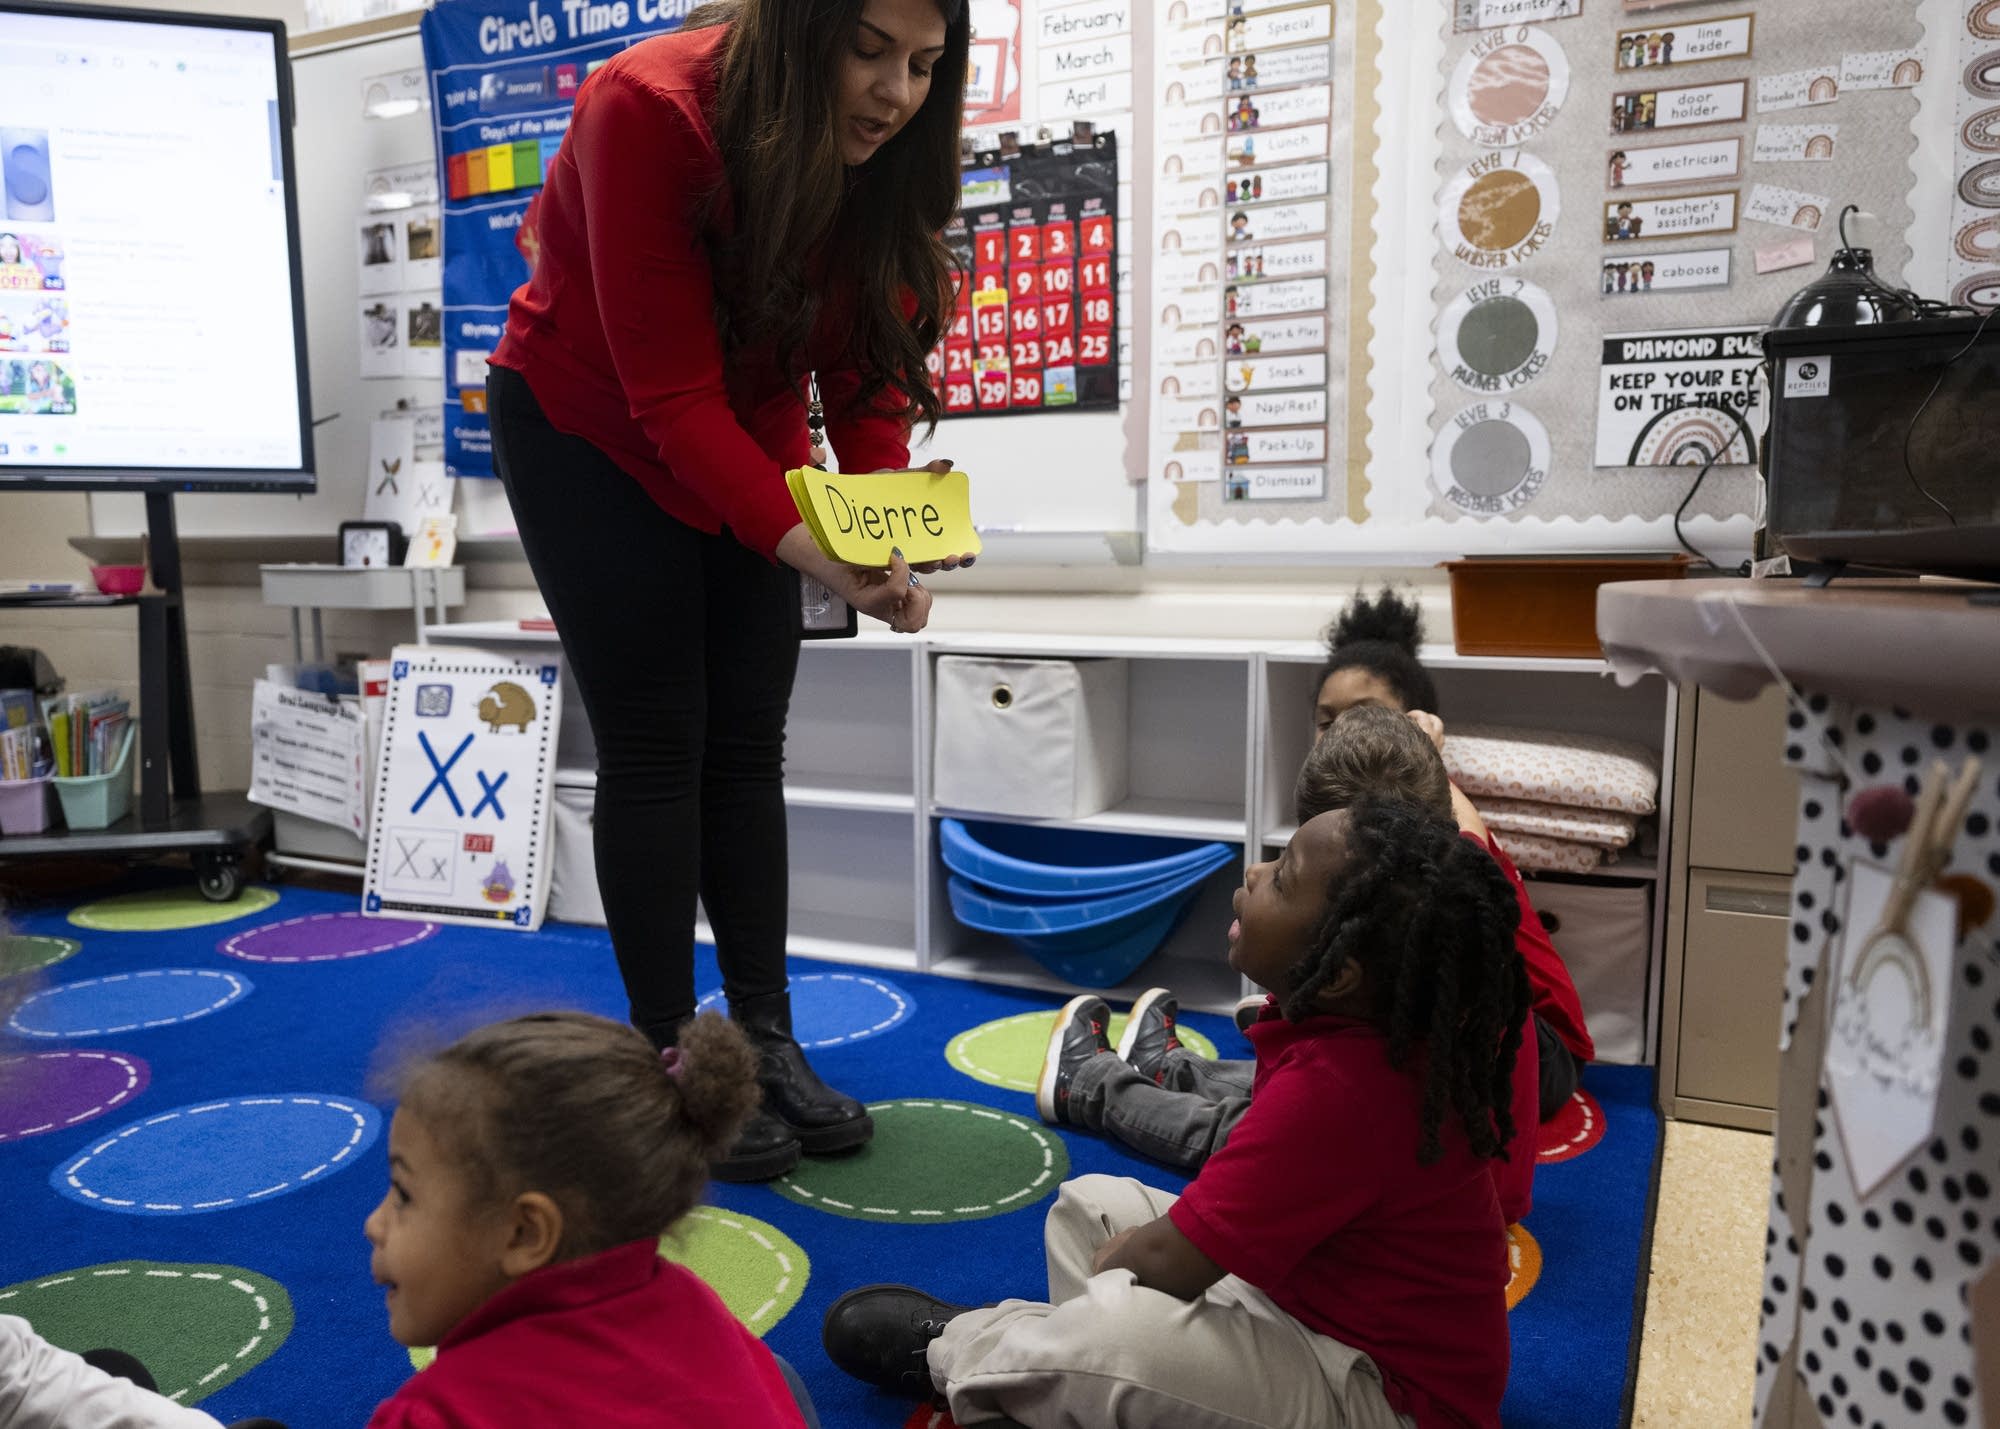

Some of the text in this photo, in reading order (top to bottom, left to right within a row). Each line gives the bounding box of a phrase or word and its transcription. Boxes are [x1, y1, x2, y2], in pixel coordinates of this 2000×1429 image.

[479, 0, 702, 54] Circle Time Cen
[1044, 10, 1126, 37] February
[1267, 16, 1315, 38] Special
[1697, 28, 1722, 39] line
[1470, 30, 1506, 58] LEVEL
[1686, 40, 1732, 54] leader
[1056, 47, 1113, 71] March
[1845, 71, 1880, 82] Dierre
[1064, 84, 1106, 109] April
[1677, 92, 1714, 106] door
[1671, 105, 1719, 119] holder
[1269, 134, 1309, 151] Lunch
[1467, 151, 1503, 179] LEVEL
[1653, 154, 1728, 170] electrician
[1654, 200, 1720, 216] teacher's
[1752, 200, 1778, 216] Zoey
[1657, 212, 1715, 229] assistant
[985, 224, 1104, 261] 1 2 3 4
[1511, 221, 1552, 263] VOICES
[1268, 254, 1314, 268] Recess
[1662, 261, 1720, 278] caboose
[1016, 272, 1032, 295] 9
[1044, 268, 1069, 292] 10
[1083, 263, 1106, 286] 11
[1465, 278, 1524, 305] LEVEL 2
[980, 311, 1003, 334] 15
[1013, 308, 1038, 331] 16
[1045, 303, 1069, 327] 17
[1085, 298, 1109, 322] 18
[949, 348, 972, 371] 21
[1013, 341, 1040, 366] 23
[1045, 337, 1073, 363] 24
[1081, 335, 1108, 359] 25
[1622, 335, 1765, 360] DIAMOND RUL
[1268, 366, 1305, 379] Snack
[1505, 349, 1548, 389] VOICES
[1609, 368, 1757, 390] KEEP YOUR EY
[947, 377, 1039, 406] 28 29 30
[1787, 380, 1828, 391] REPTILES
[1256, 398, 1318, 416] Nap/Rest
[1614, 389, 1761, 412] ON THE TARGE
[1454, 402, 1511, 430] LEVEL 3
[1259, 438, 1315, 453] Pack-Up
[1255, 469, 1317, 487] Dismissal
[825, 484, 943, 540] Dierre
